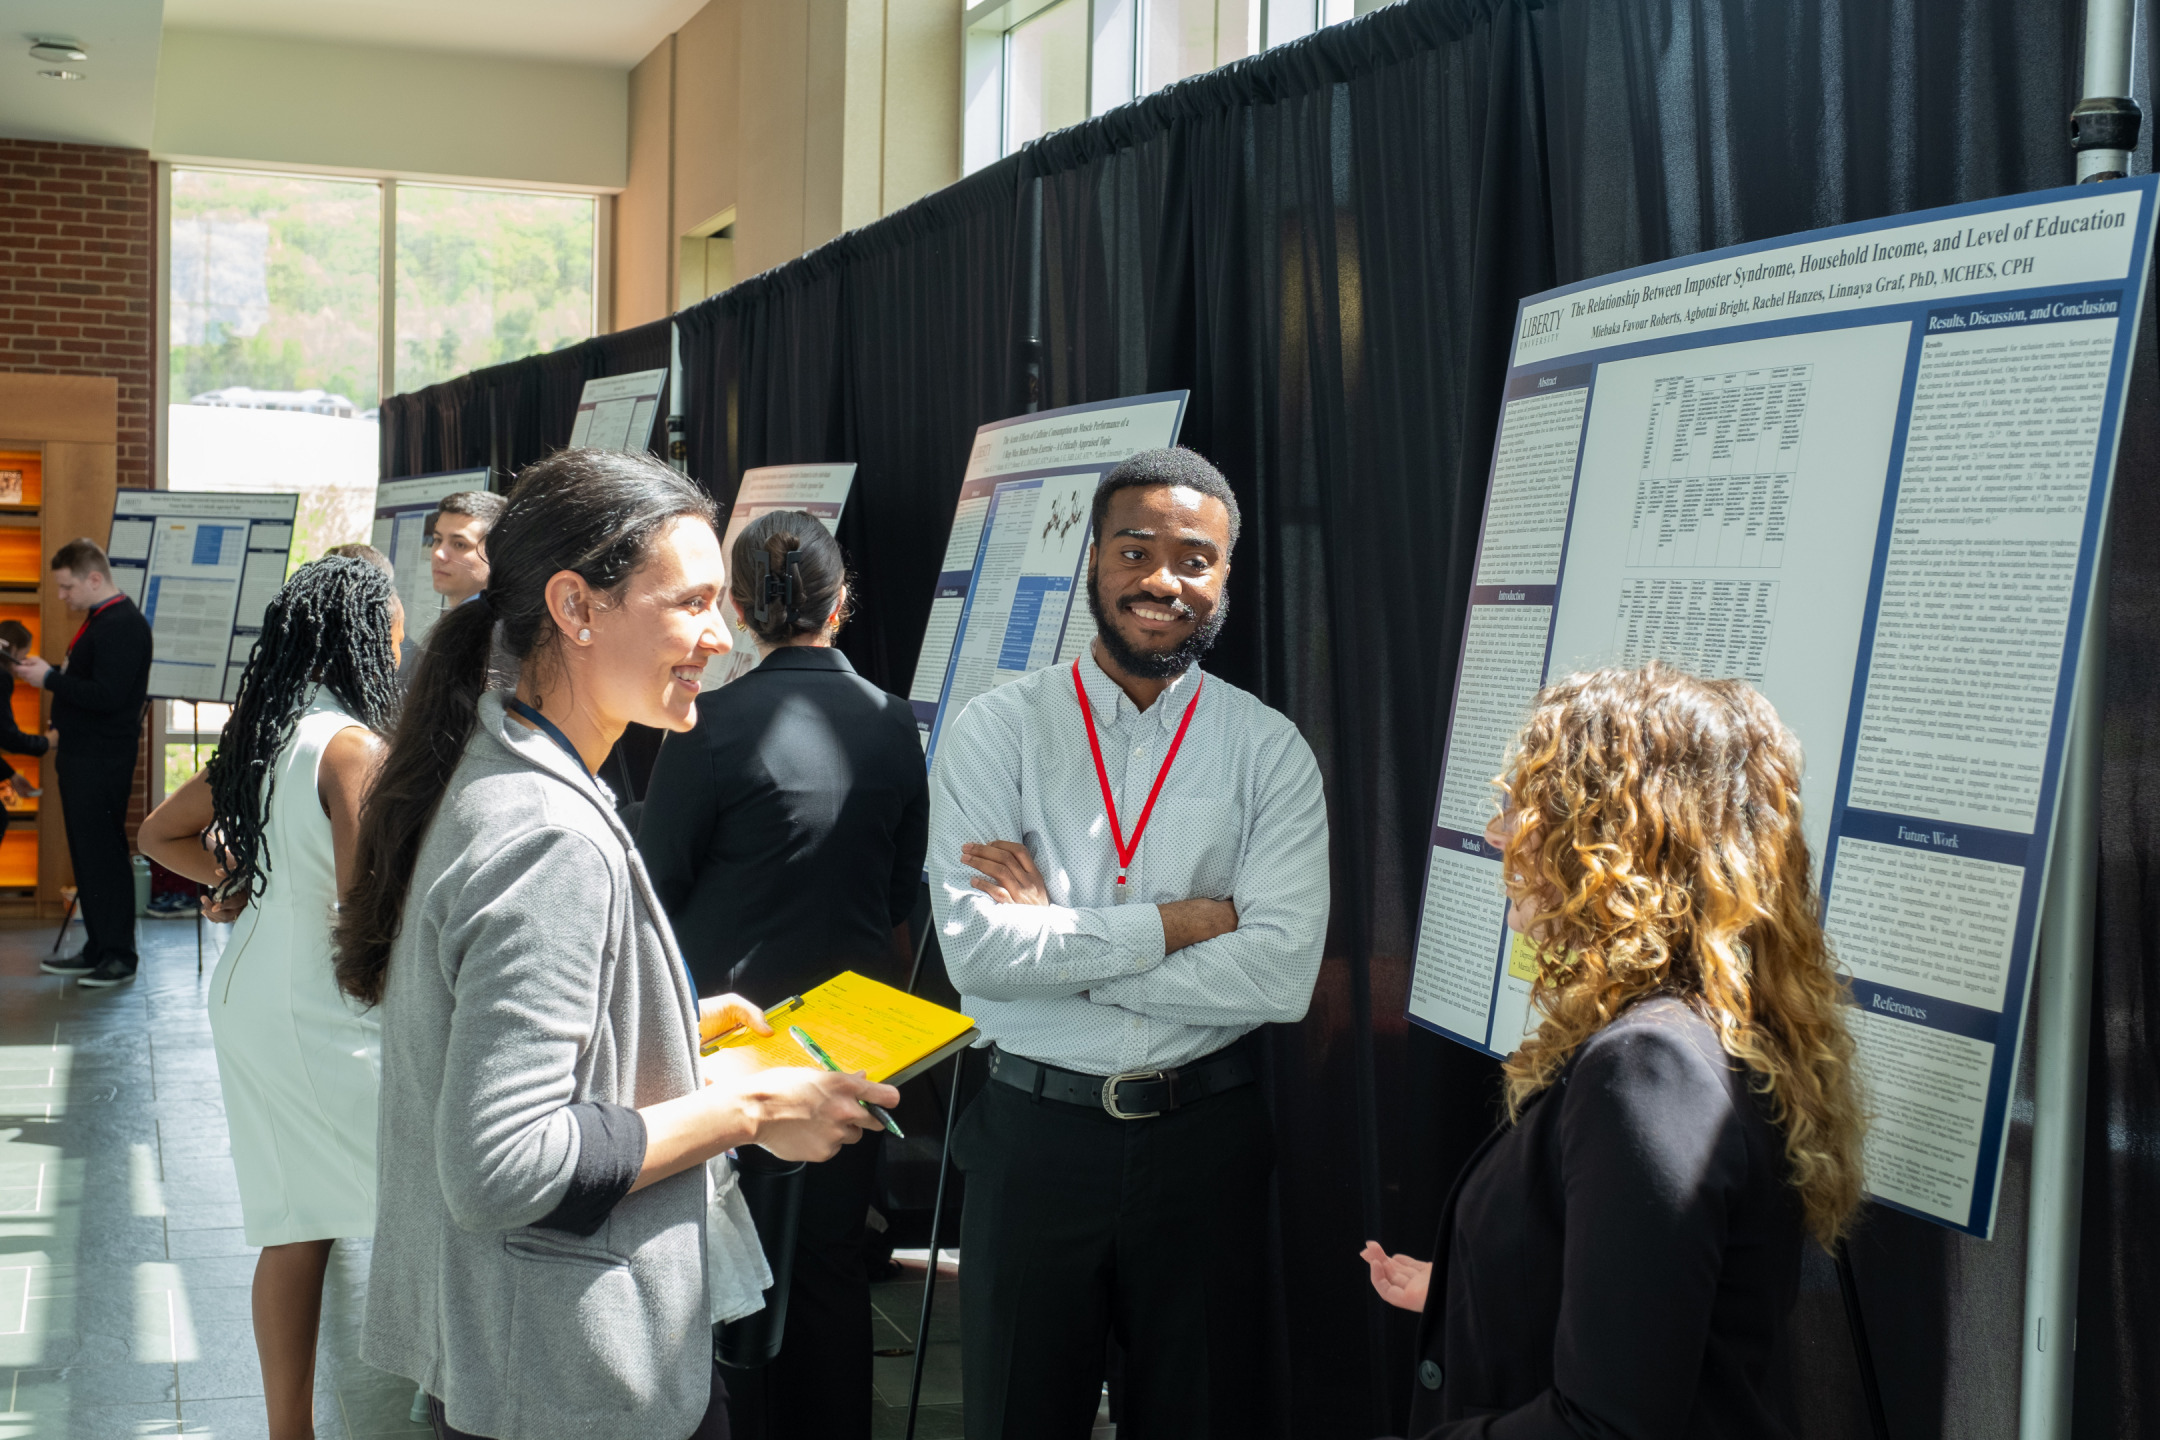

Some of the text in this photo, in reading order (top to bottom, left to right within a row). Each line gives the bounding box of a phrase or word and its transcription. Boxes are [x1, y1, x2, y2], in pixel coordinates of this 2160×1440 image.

[1571, 210, 2125, 318] The Relationship Between Imposter Syndrome, Household Income, and Level of Education
[1622, 319, 1648, 332] Favour
[1650, 312, 1682, 327] Roberts,
[1719, 299, 1749, 317] Bright,
[1752, 292, 1785, 310] Rachel
[1787, 290, 1825, 305] Hanzes,
[1828, 283, 1872, 299] Linnaya
[1875, 274, 1905, 292] Graf,
[1909, 270, 1937, 288] PhD,
[1942, 262, 1996, 283] MCHES,
[2001, 257, 2034, 276] CPH
[1521, 308, 1564, 339] LIBERTY
[1929, 299, 2117, 329] Results, Discussion, and Conclusion
[1519, 333, 1560, 350] UNIVERSITY
[1537, 376, 1558, 388] Abstract
[1498, 589, 1526, 601] Introduction
[1462, 838, 1481, 852] Methods
[1898, 826, 1960, 848] Future Work
[1873, 993, 1928, 1019] References
